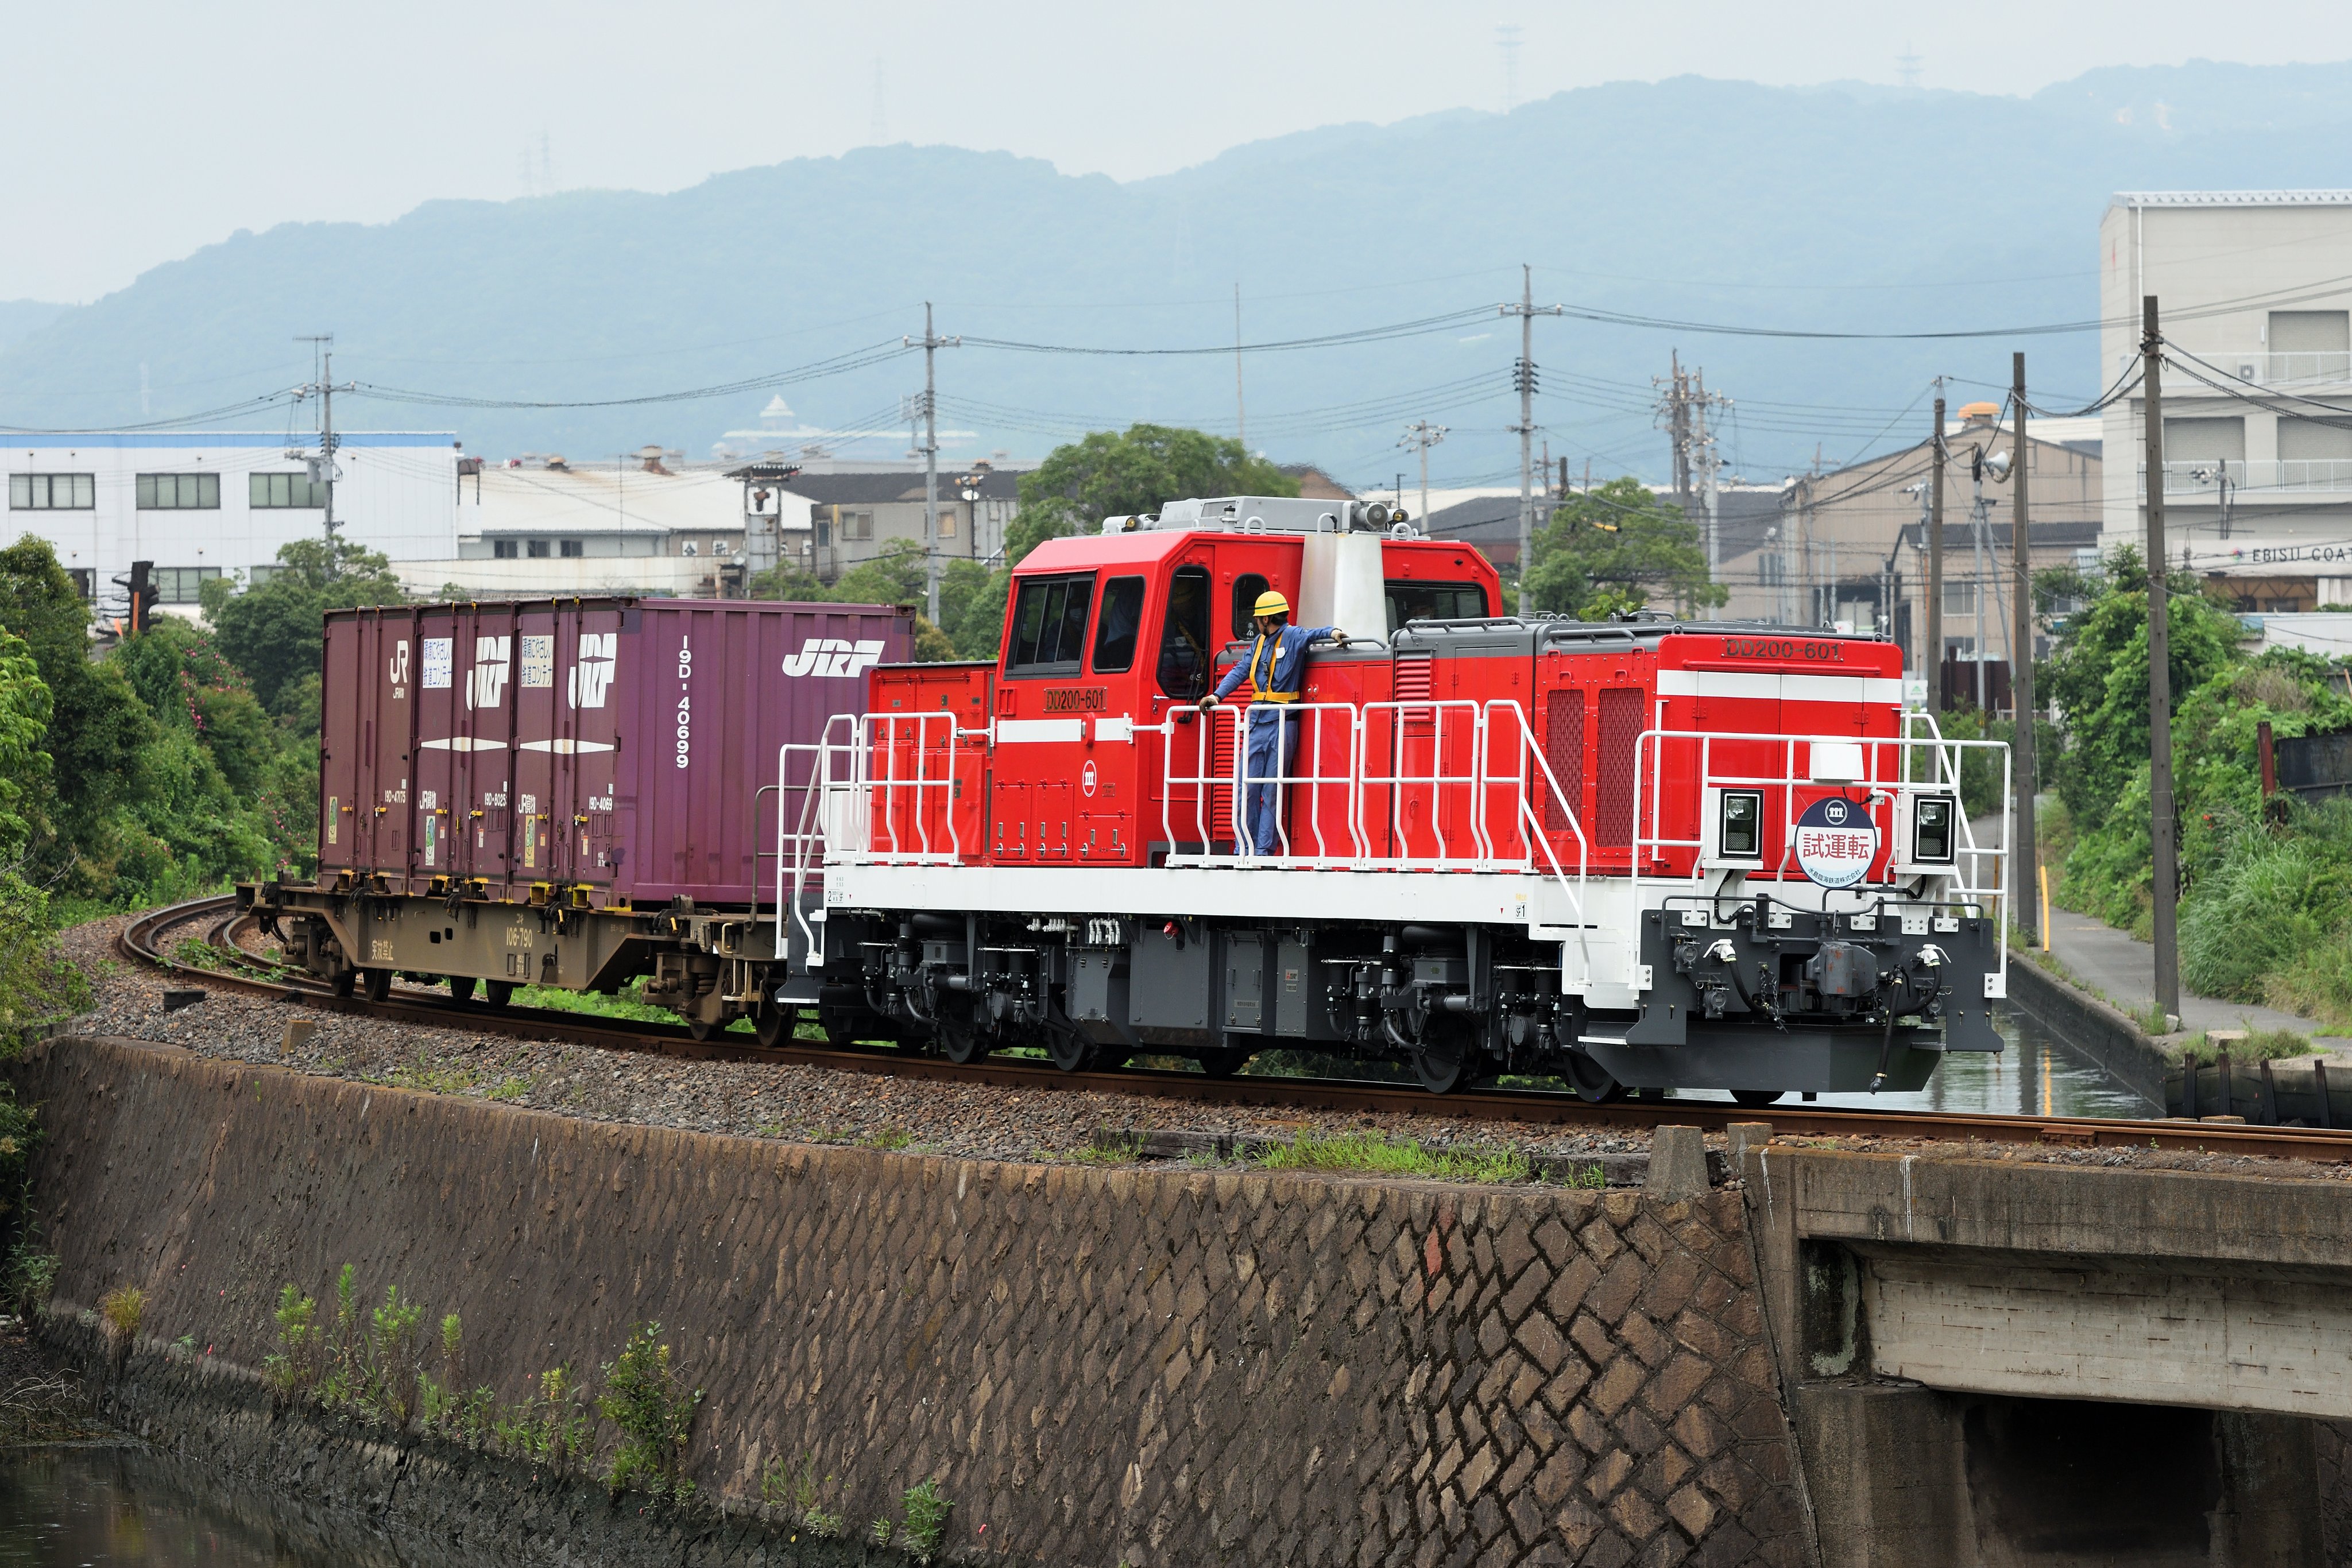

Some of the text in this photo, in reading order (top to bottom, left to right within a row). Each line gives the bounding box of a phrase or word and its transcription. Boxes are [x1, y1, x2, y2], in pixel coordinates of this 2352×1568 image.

[2253, 548, 2300, 562] EBISU
[782, 638, 885, 677] JRF
[1727, 639, 1838, 660] DD200-601
[390, 640, 408, 684] JR
[676, 635, 691, 769] 19D-40699
[1047, 690, 1103, 710] DD200-601
[519, 794, 535, 814] JR貨物
[1803, 833, 1869, 860] 試運転
[1808, 868, 1861, 884] 水島臨海鉄道株式会社
[506, 927, 532, 948] 106-790
